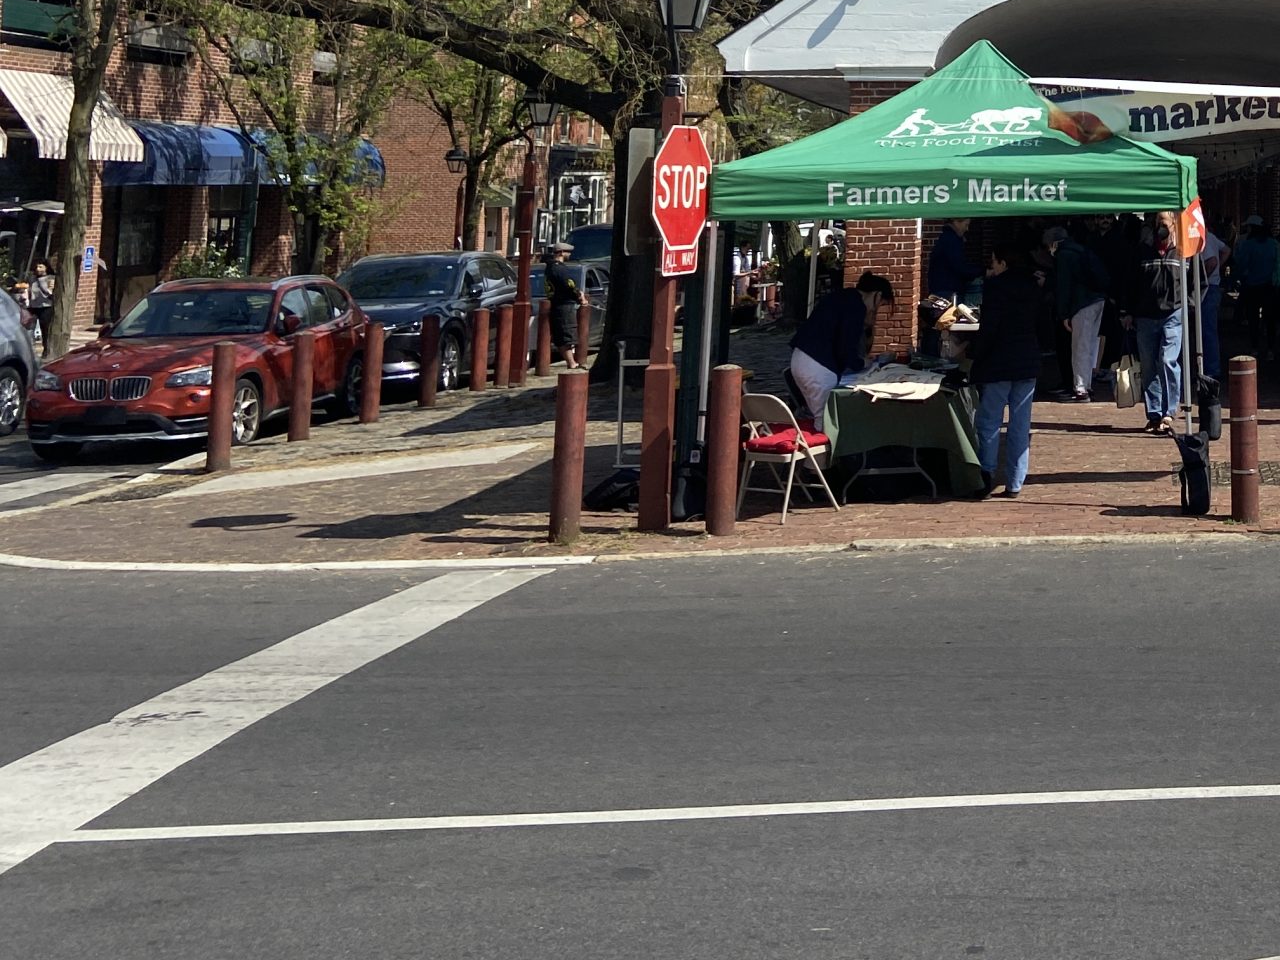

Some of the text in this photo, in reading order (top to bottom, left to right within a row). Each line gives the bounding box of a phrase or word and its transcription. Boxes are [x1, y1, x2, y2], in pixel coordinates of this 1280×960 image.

[875, 135, 1043, 147] The Food Trust
[657, 164, 708, 209] STOP
[967, 178, 1068, 203] Market
[665, 251, 695, 267] ALL WAY
